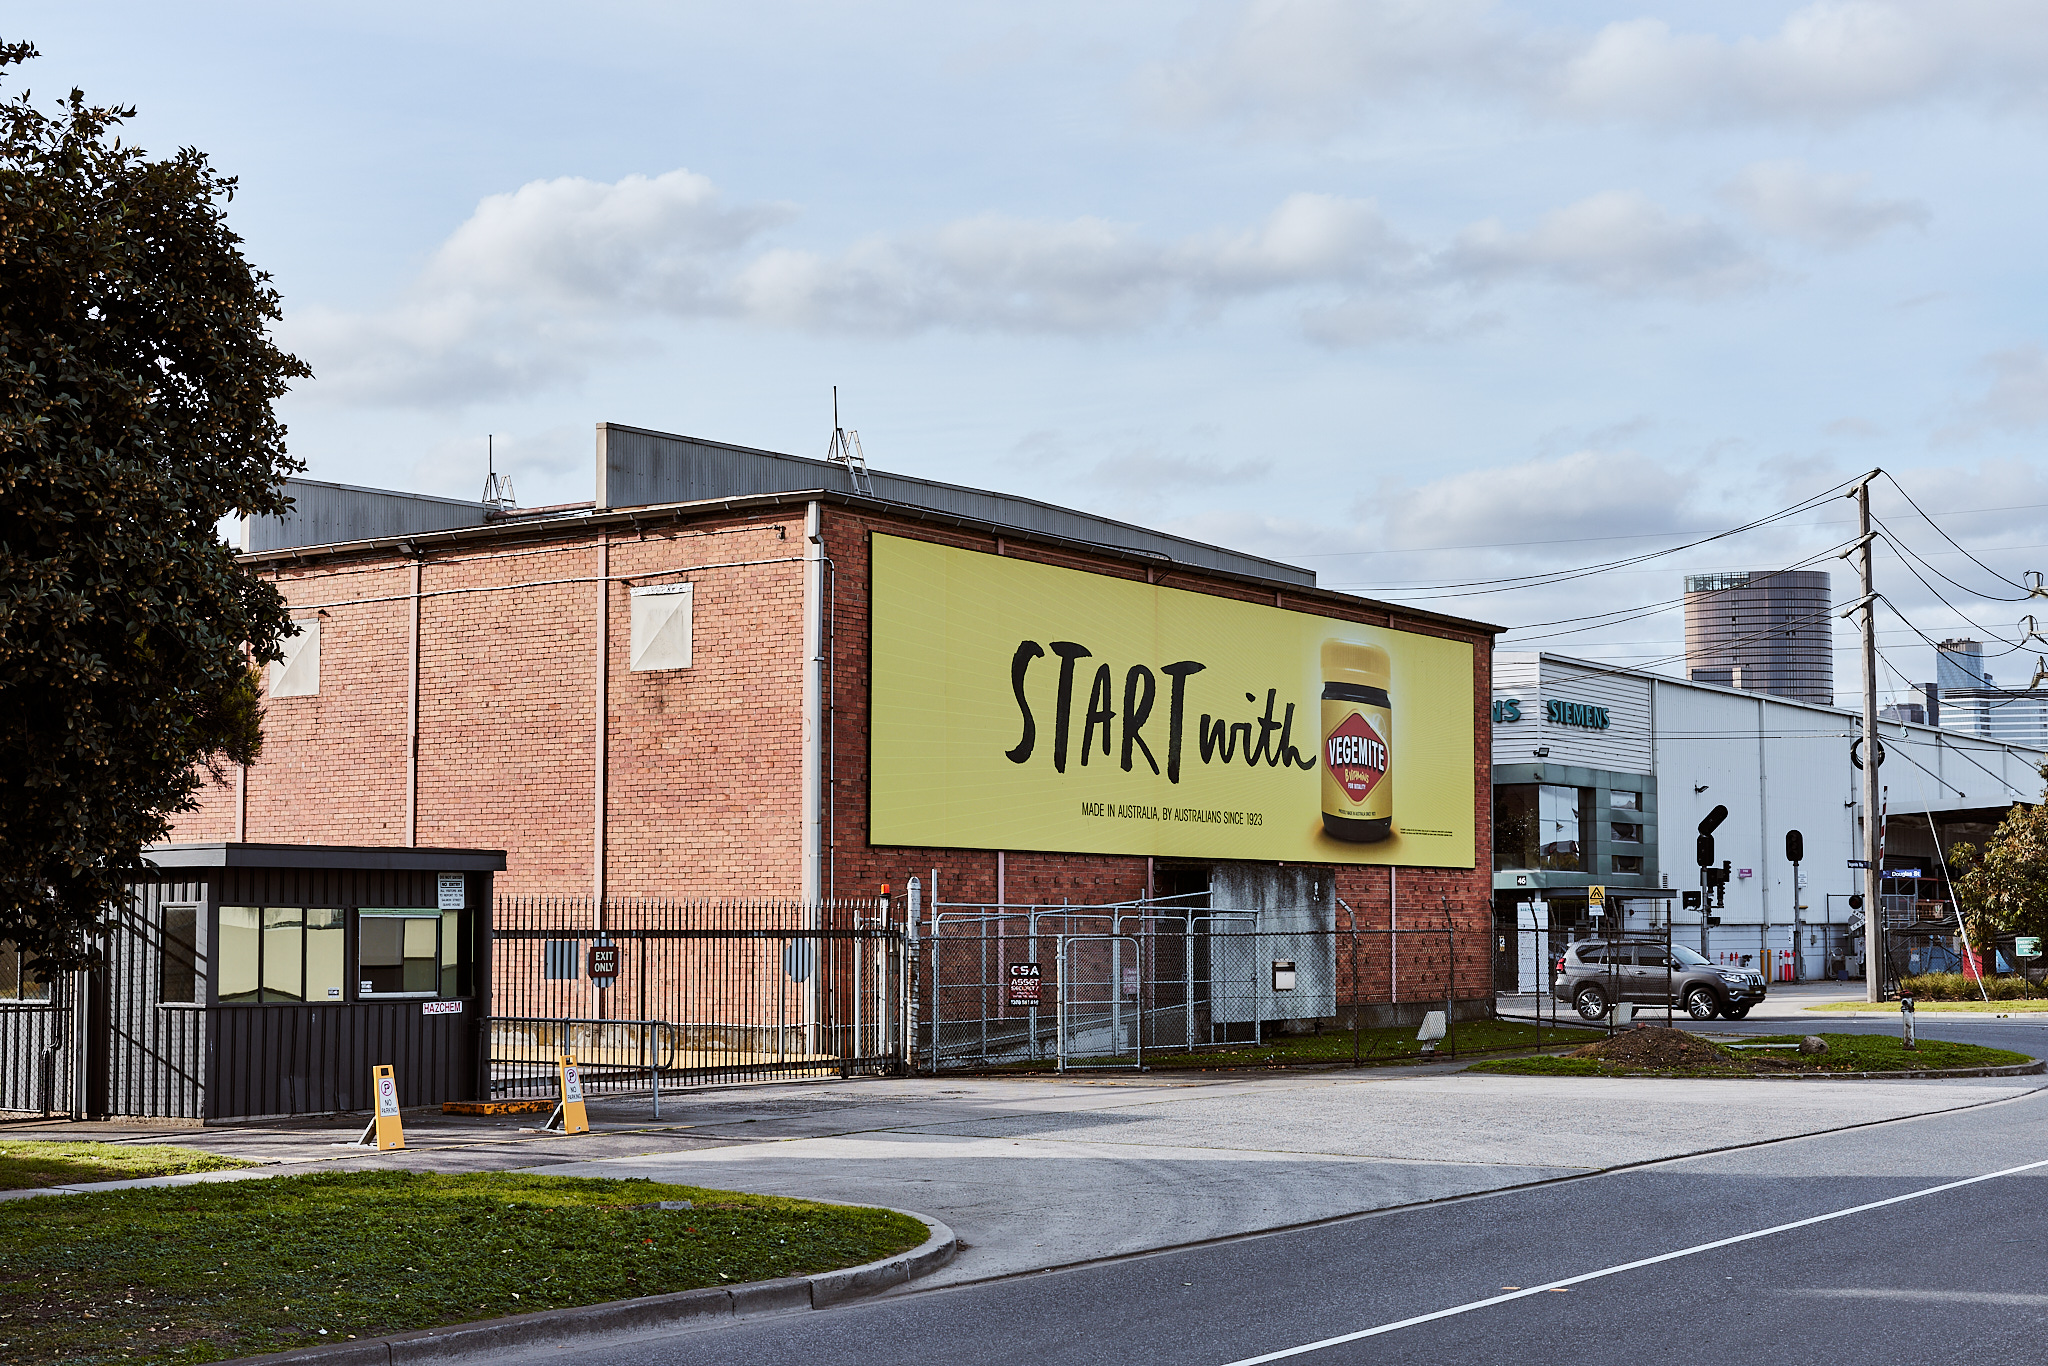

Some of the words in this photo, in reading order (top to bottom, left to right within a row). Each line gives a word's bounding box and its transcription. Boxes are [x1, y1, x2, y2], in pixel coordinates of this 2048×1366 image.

[1005, 640, 1207, 785] START
[1199, 688, 1317, 772] with
[1547, 699, 1611, 730] SIEMENS
[1328, 735, 1385, 772] VEGEMITE
[1081, 801, 1105, 817] MADE
[1107, 803, 1116, 818] IN
[1117, 804, 1160, 822] AUSTRALIA,
[1162, 807, 1173, 821] BY
[1174, 807, 1222, 824] AUSTRALIANS
[1223, 810, 1244, 825] SINCE
[1246, 812, 1263, 826] 1923
[1517, 877, 1527, 885] 46
[595, 951, 614, 961] EXIT
[594, 962, 615, 973] ONLY
[1010, 965, 1040, 976] CSA
[1011, 978, 1040, 986] ASSET
[423, 1001, 461, 1014] HAZCHEM
[381, 1106, 398, 1114] PARKING
